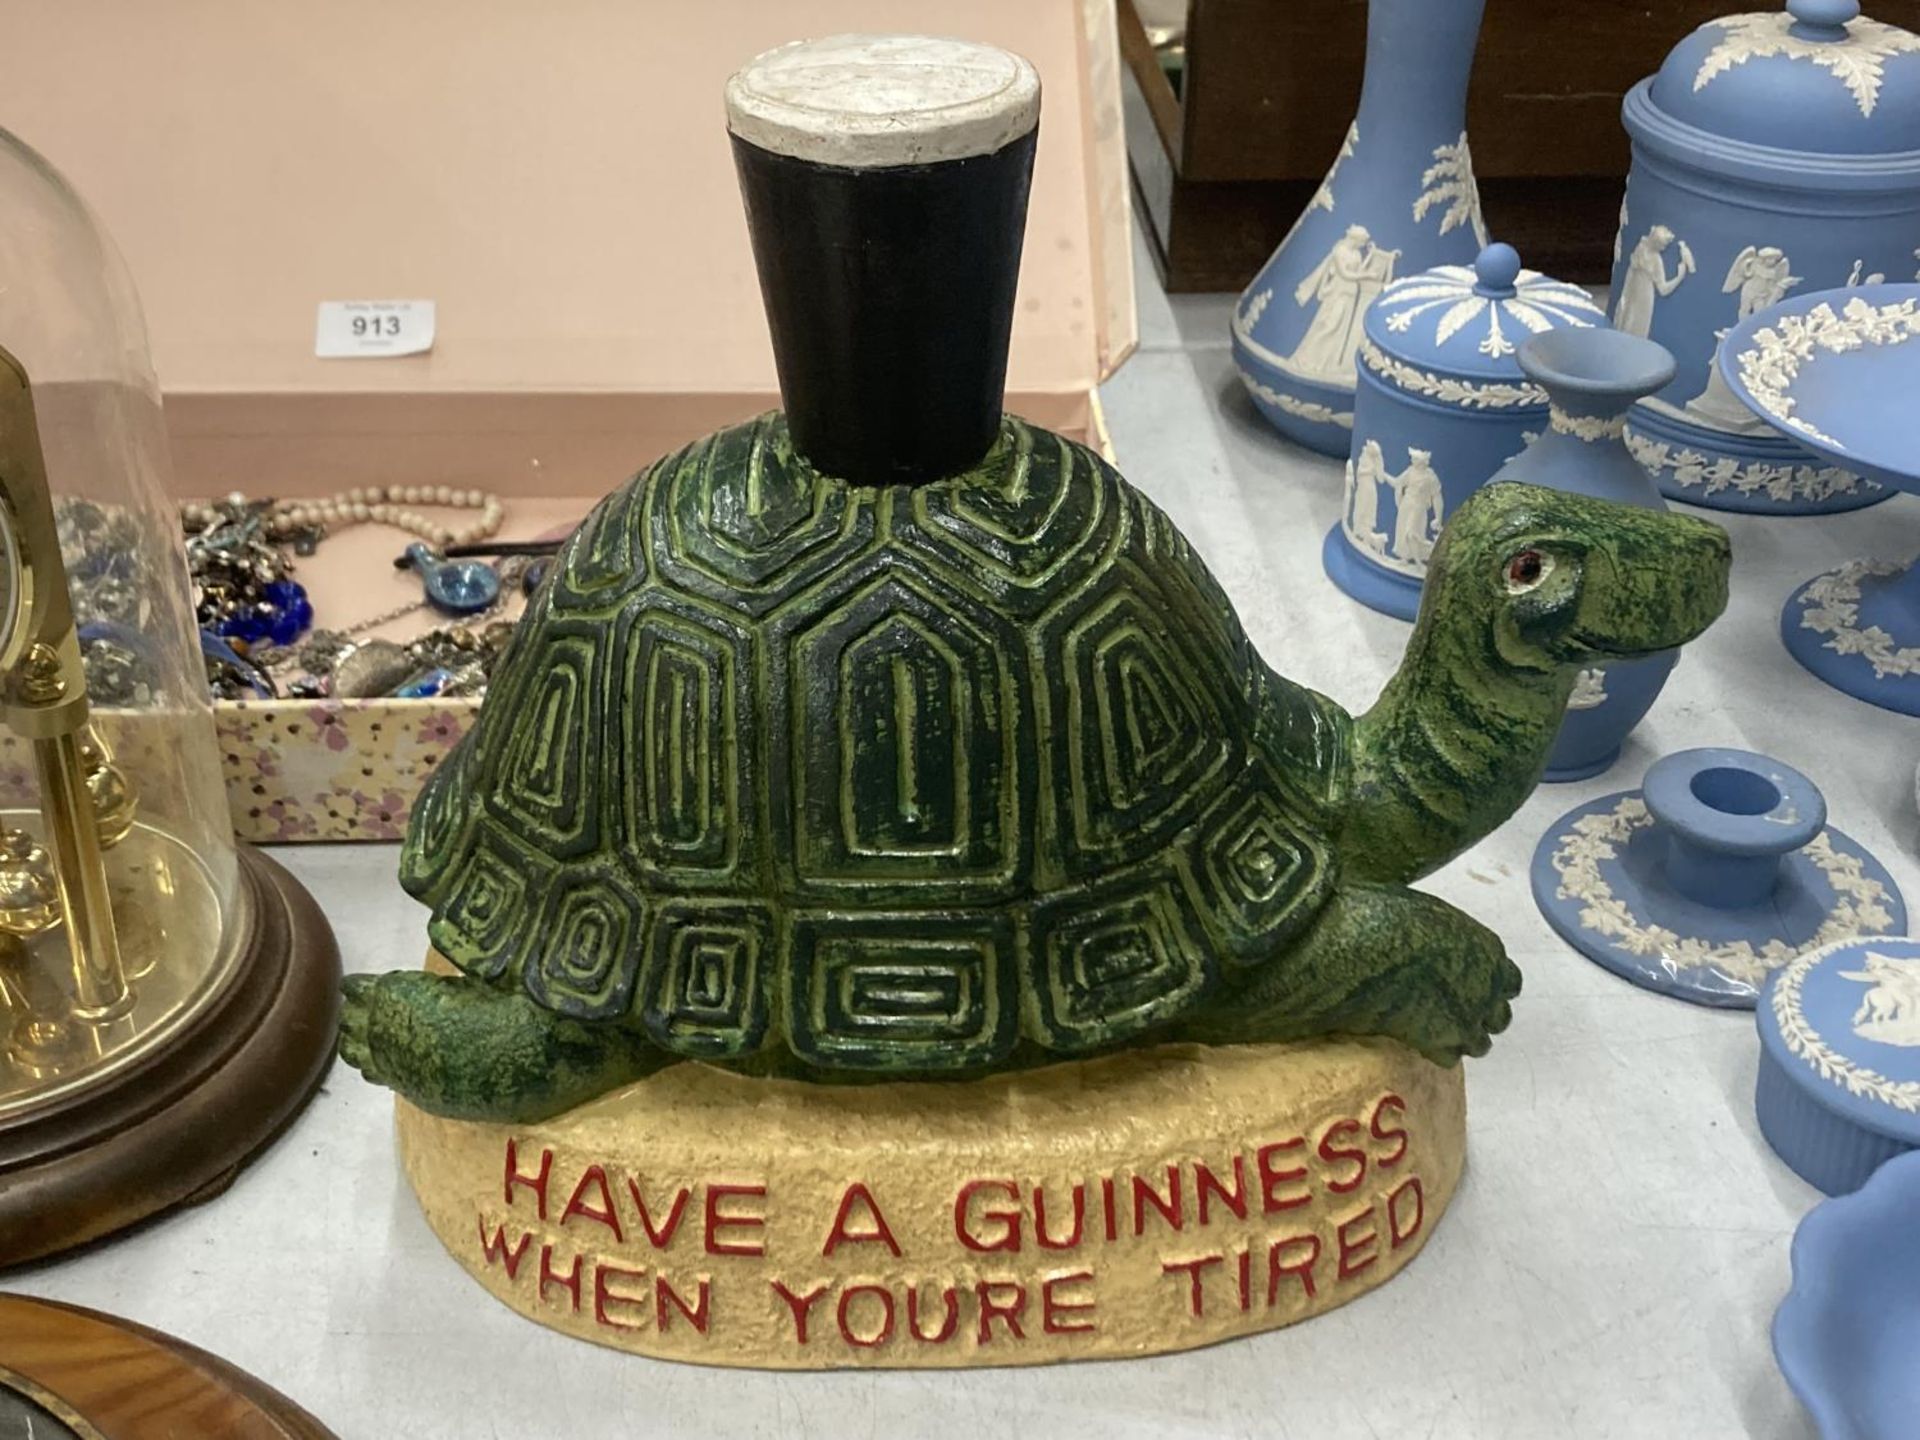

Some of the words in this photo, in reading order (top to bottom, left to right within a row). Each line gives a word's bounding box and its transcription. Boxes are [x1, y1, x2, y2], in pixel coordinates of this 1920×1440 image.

[352, 315, 401, 337] 913
[504, 1136, 767, 1257] HAVE
[822, 1182, 902, 1258] A
[954, 1093, 1409, 1254] GUINNESS
[478, 1212, 711, 1336] WHEN
[770, 1271, 1097, 1348] YOURE
[1161, 1177, 1425, 1318] TIRED
